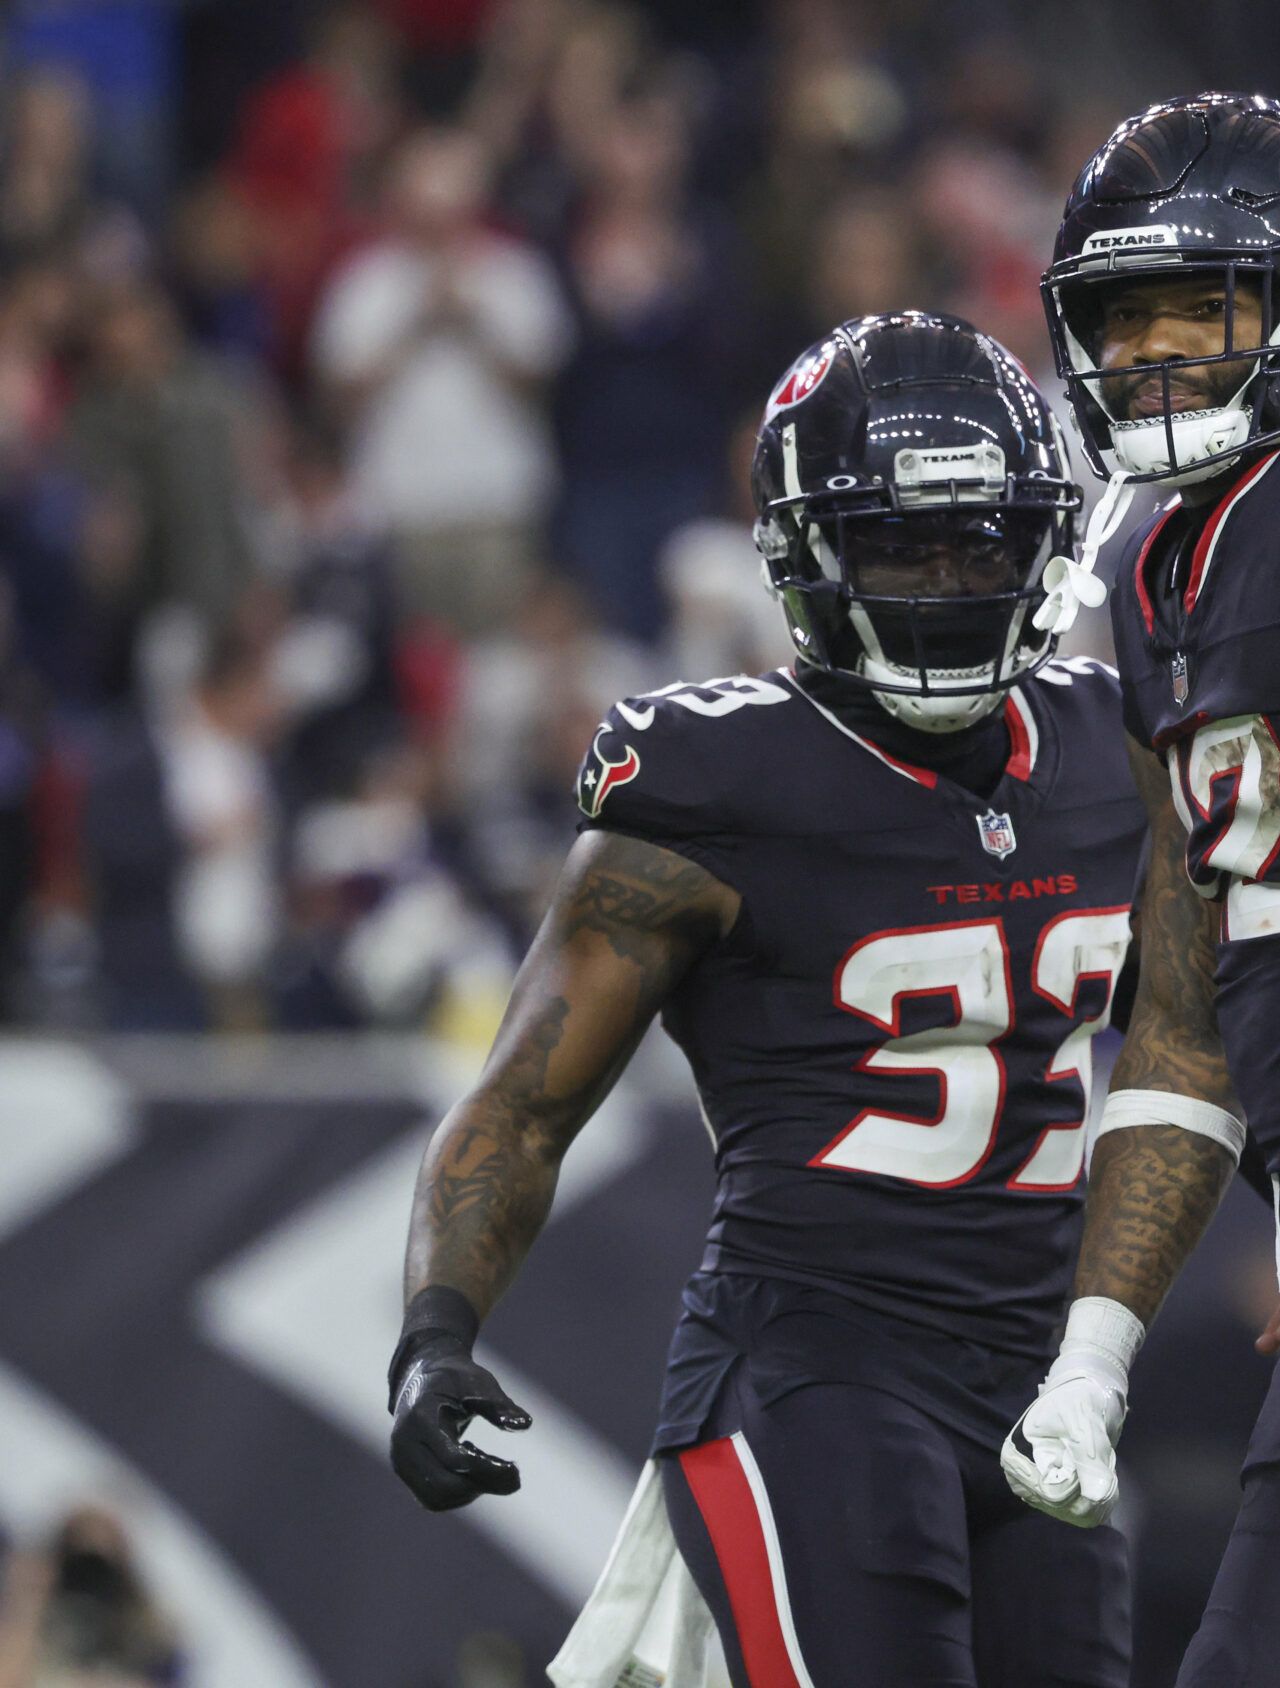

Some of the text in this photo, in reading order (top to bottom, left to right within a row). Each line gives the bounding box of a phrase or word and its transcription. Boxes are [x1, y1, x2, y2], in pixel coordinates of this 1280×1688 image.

[1089, 234, 1166, 249] TEXANS
[921, 453, 976, 463] TEXANS
[926, 873, 1079, 905] TEXANS
